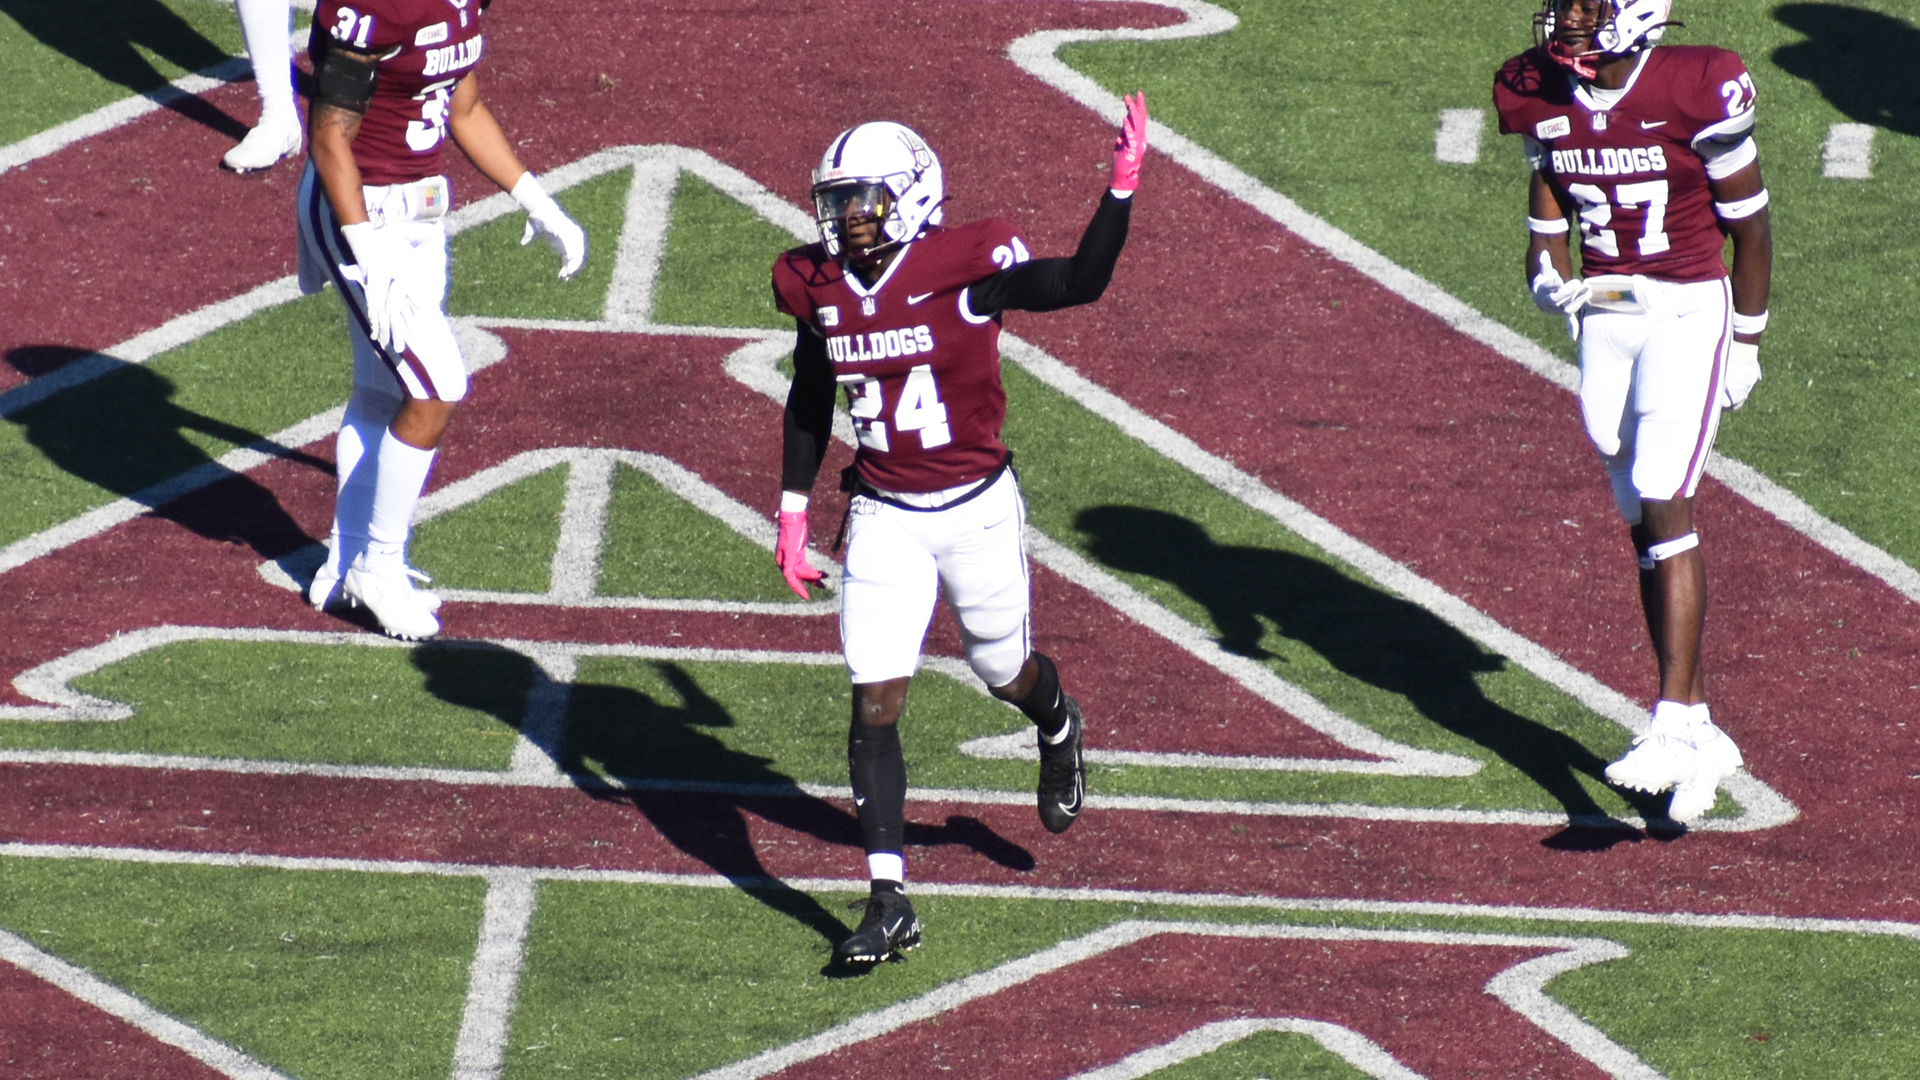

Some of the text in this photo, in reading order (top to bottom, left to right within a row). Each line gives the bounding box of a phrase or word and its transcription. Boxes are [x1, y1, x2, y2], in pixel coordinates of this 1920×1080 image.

[330, 6, 372, 48] 31
[1721, 71, 1757, 117] 27
[1552, 146, 1668, 175] BULLDOGS
[1568, 179, 1671, 257] 27
[836, 364, 952, 453] 24
